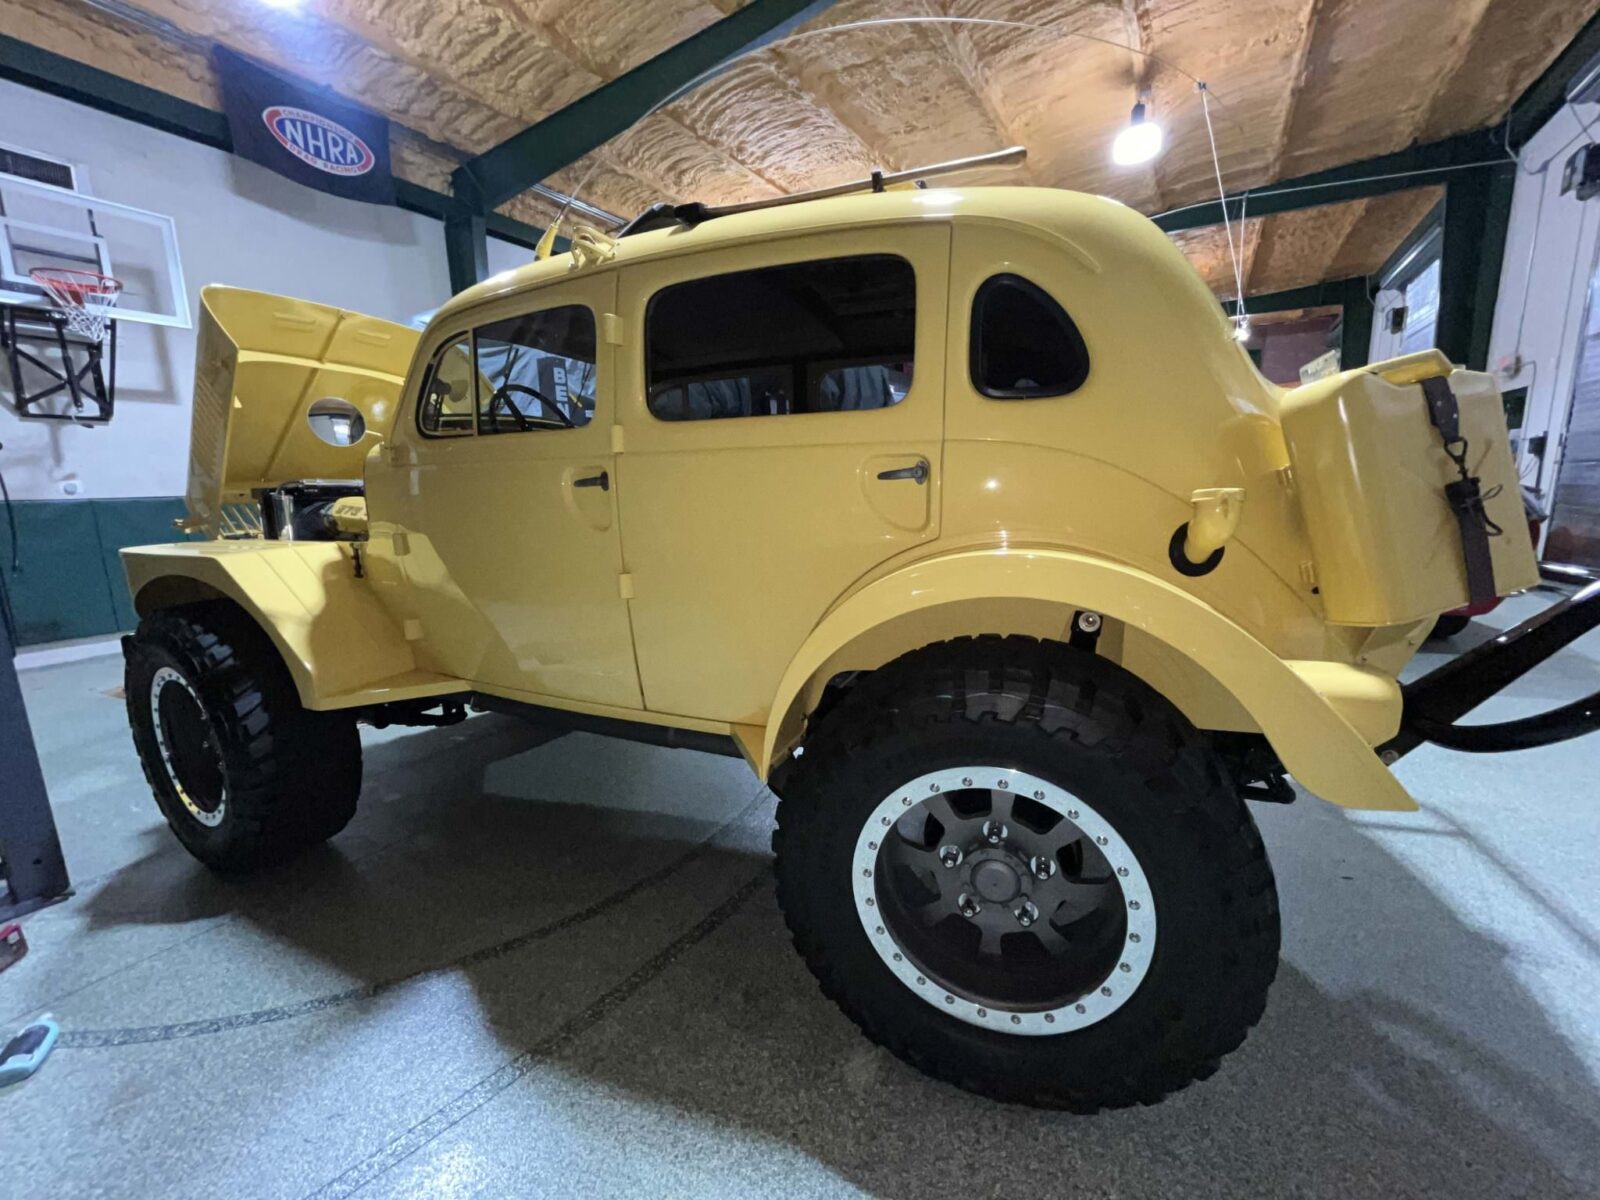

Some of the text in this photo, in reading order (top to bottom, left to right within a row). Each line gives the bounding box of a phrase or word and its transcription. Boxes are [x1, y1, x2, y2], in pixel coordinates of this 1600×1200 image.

[284, 119, 358, 164] NHRA
[288, 144, 358, 174] DRAG RACING
